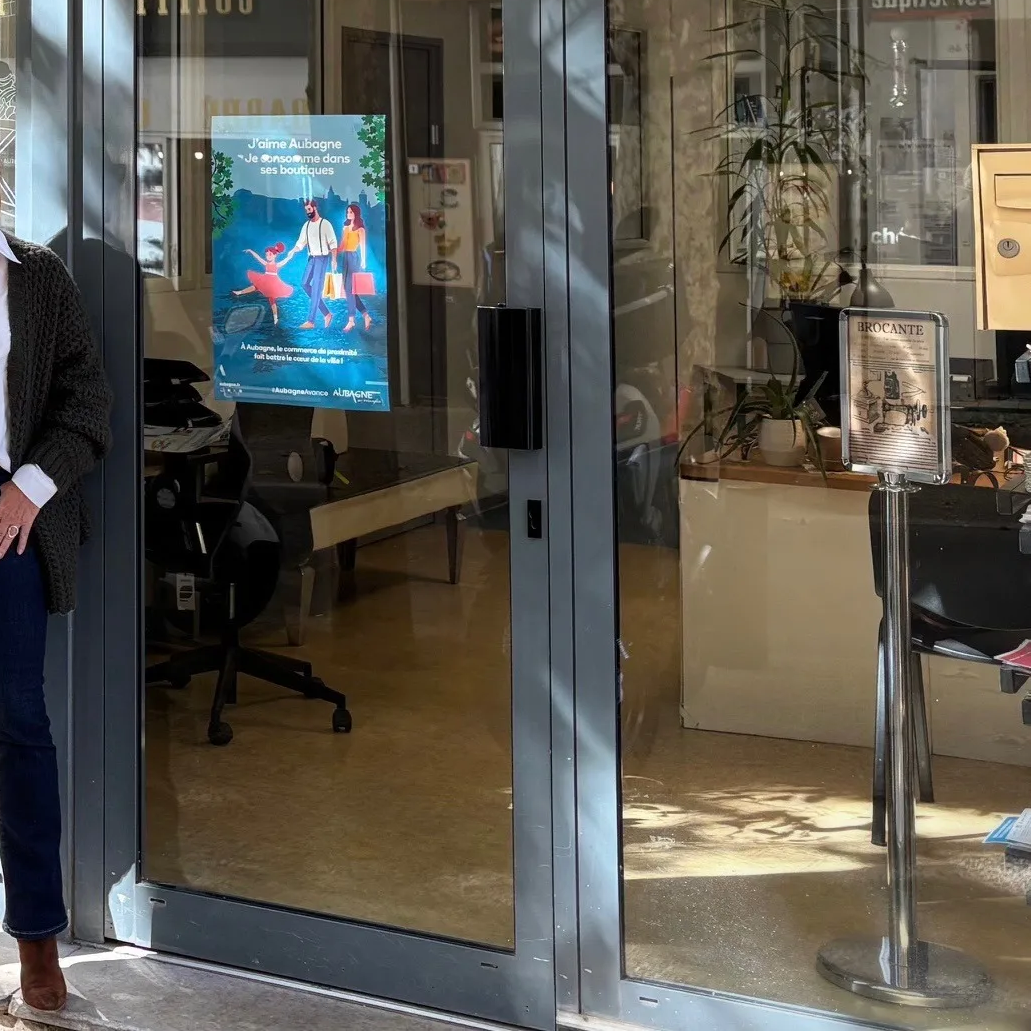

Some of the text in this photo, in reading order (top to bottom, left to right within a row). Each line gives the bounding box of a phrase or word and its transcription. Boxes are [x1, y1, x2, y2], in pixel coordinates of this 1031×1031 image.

[289, 138, 342, 152] Aubagne
[245, 153, 258, 164] Je
[323, 153, 350, 164] dans
[260, 165, 334, 178] ses boutiques
[857, 321, 924, 336] BROCANTE
[266, 353, 285, 361] battre
[333, 387, 376, 403] AUBAGNE
